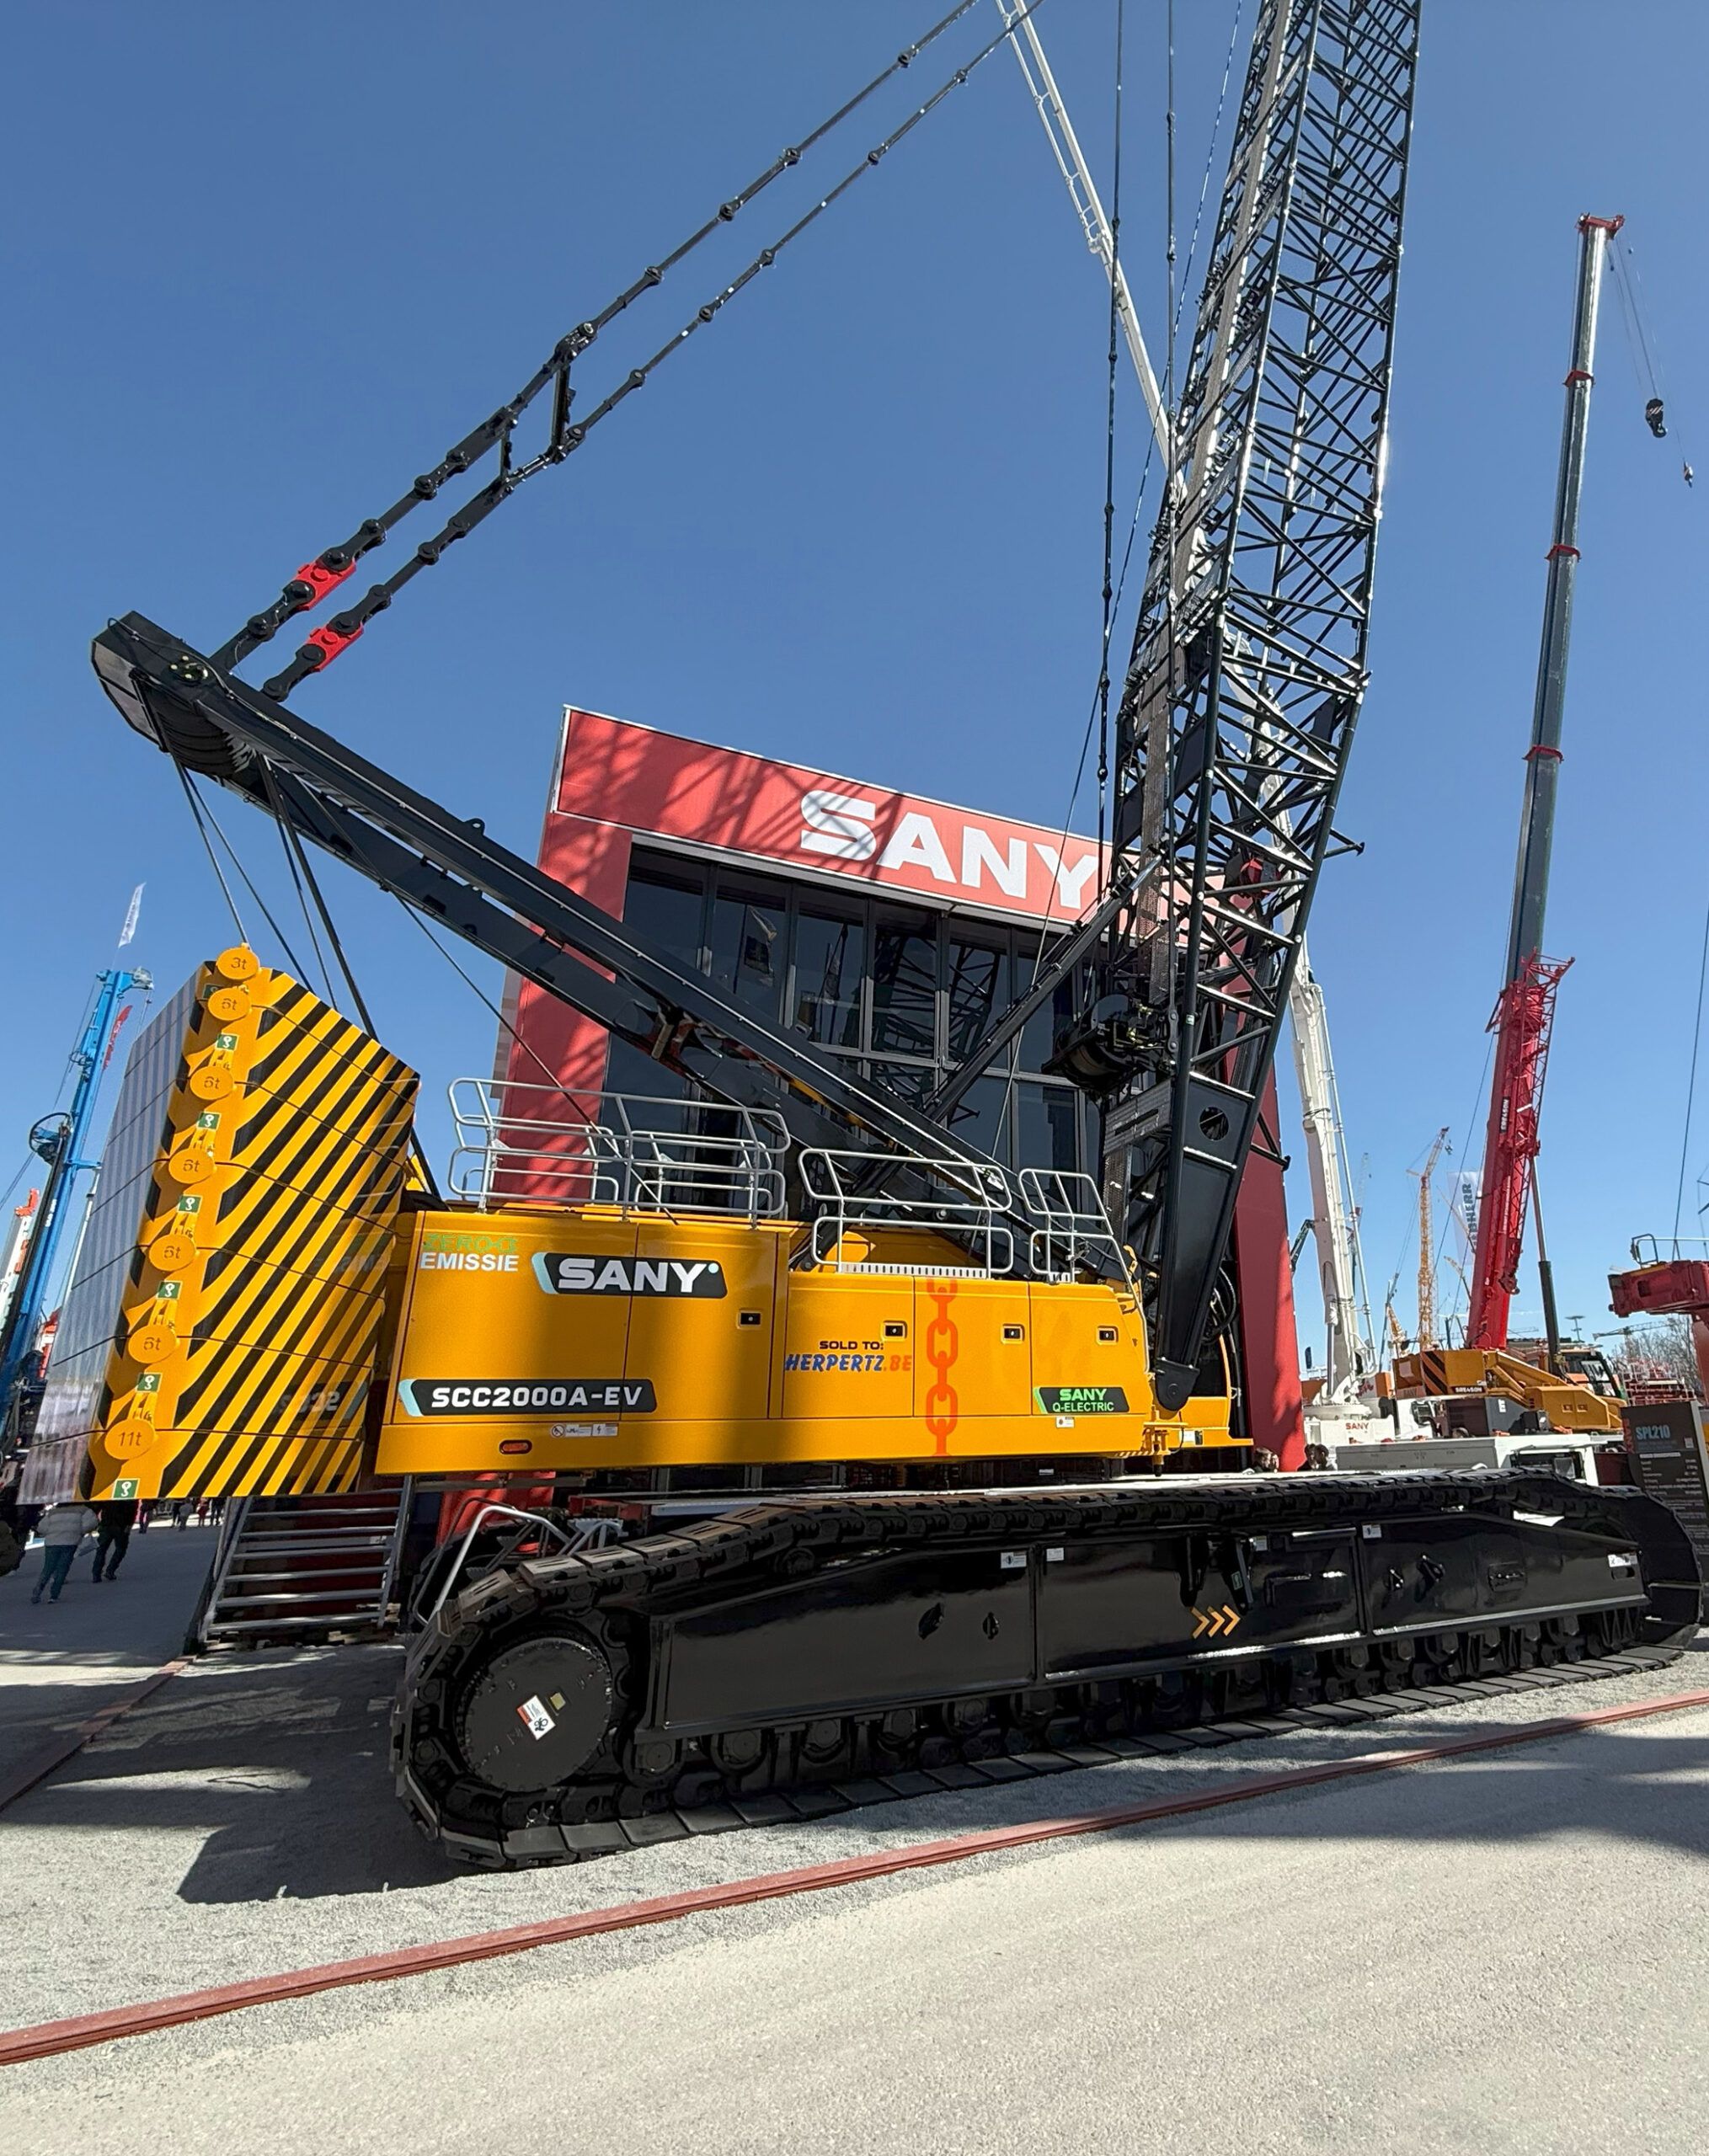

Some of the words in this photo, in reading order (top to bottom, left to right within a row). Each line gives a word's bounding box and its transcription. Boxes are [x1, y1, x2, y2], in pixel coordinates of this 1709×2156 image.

[800, 789, 1098, 910] SANY
[230, 957, 247, 970] 3t
[182, 1159, 200, 1172] 6t
[163, 1245, 181, 1260] 6t
[419, 1251, 520, 1272] EMISSIE
[558, 1257, 708, 1294] SANY
[142, 1337, 161, 1351] 6t
[819, 1340, 858, 1350] SOLD
[862, 1341, 884, 1351] TO:
[431, 1386, 643, 1408] SCC2000A-EV
[1060, 1388, 1108, 1401] SANY
[1052, 1401, 1114, 1412] Q-ELECTRIC
[1345, 1422, 1370, 1430] SANY
[1636, 1424, 1670, 1440] SPL210
[117, 1432, 142, 1447] 11t
